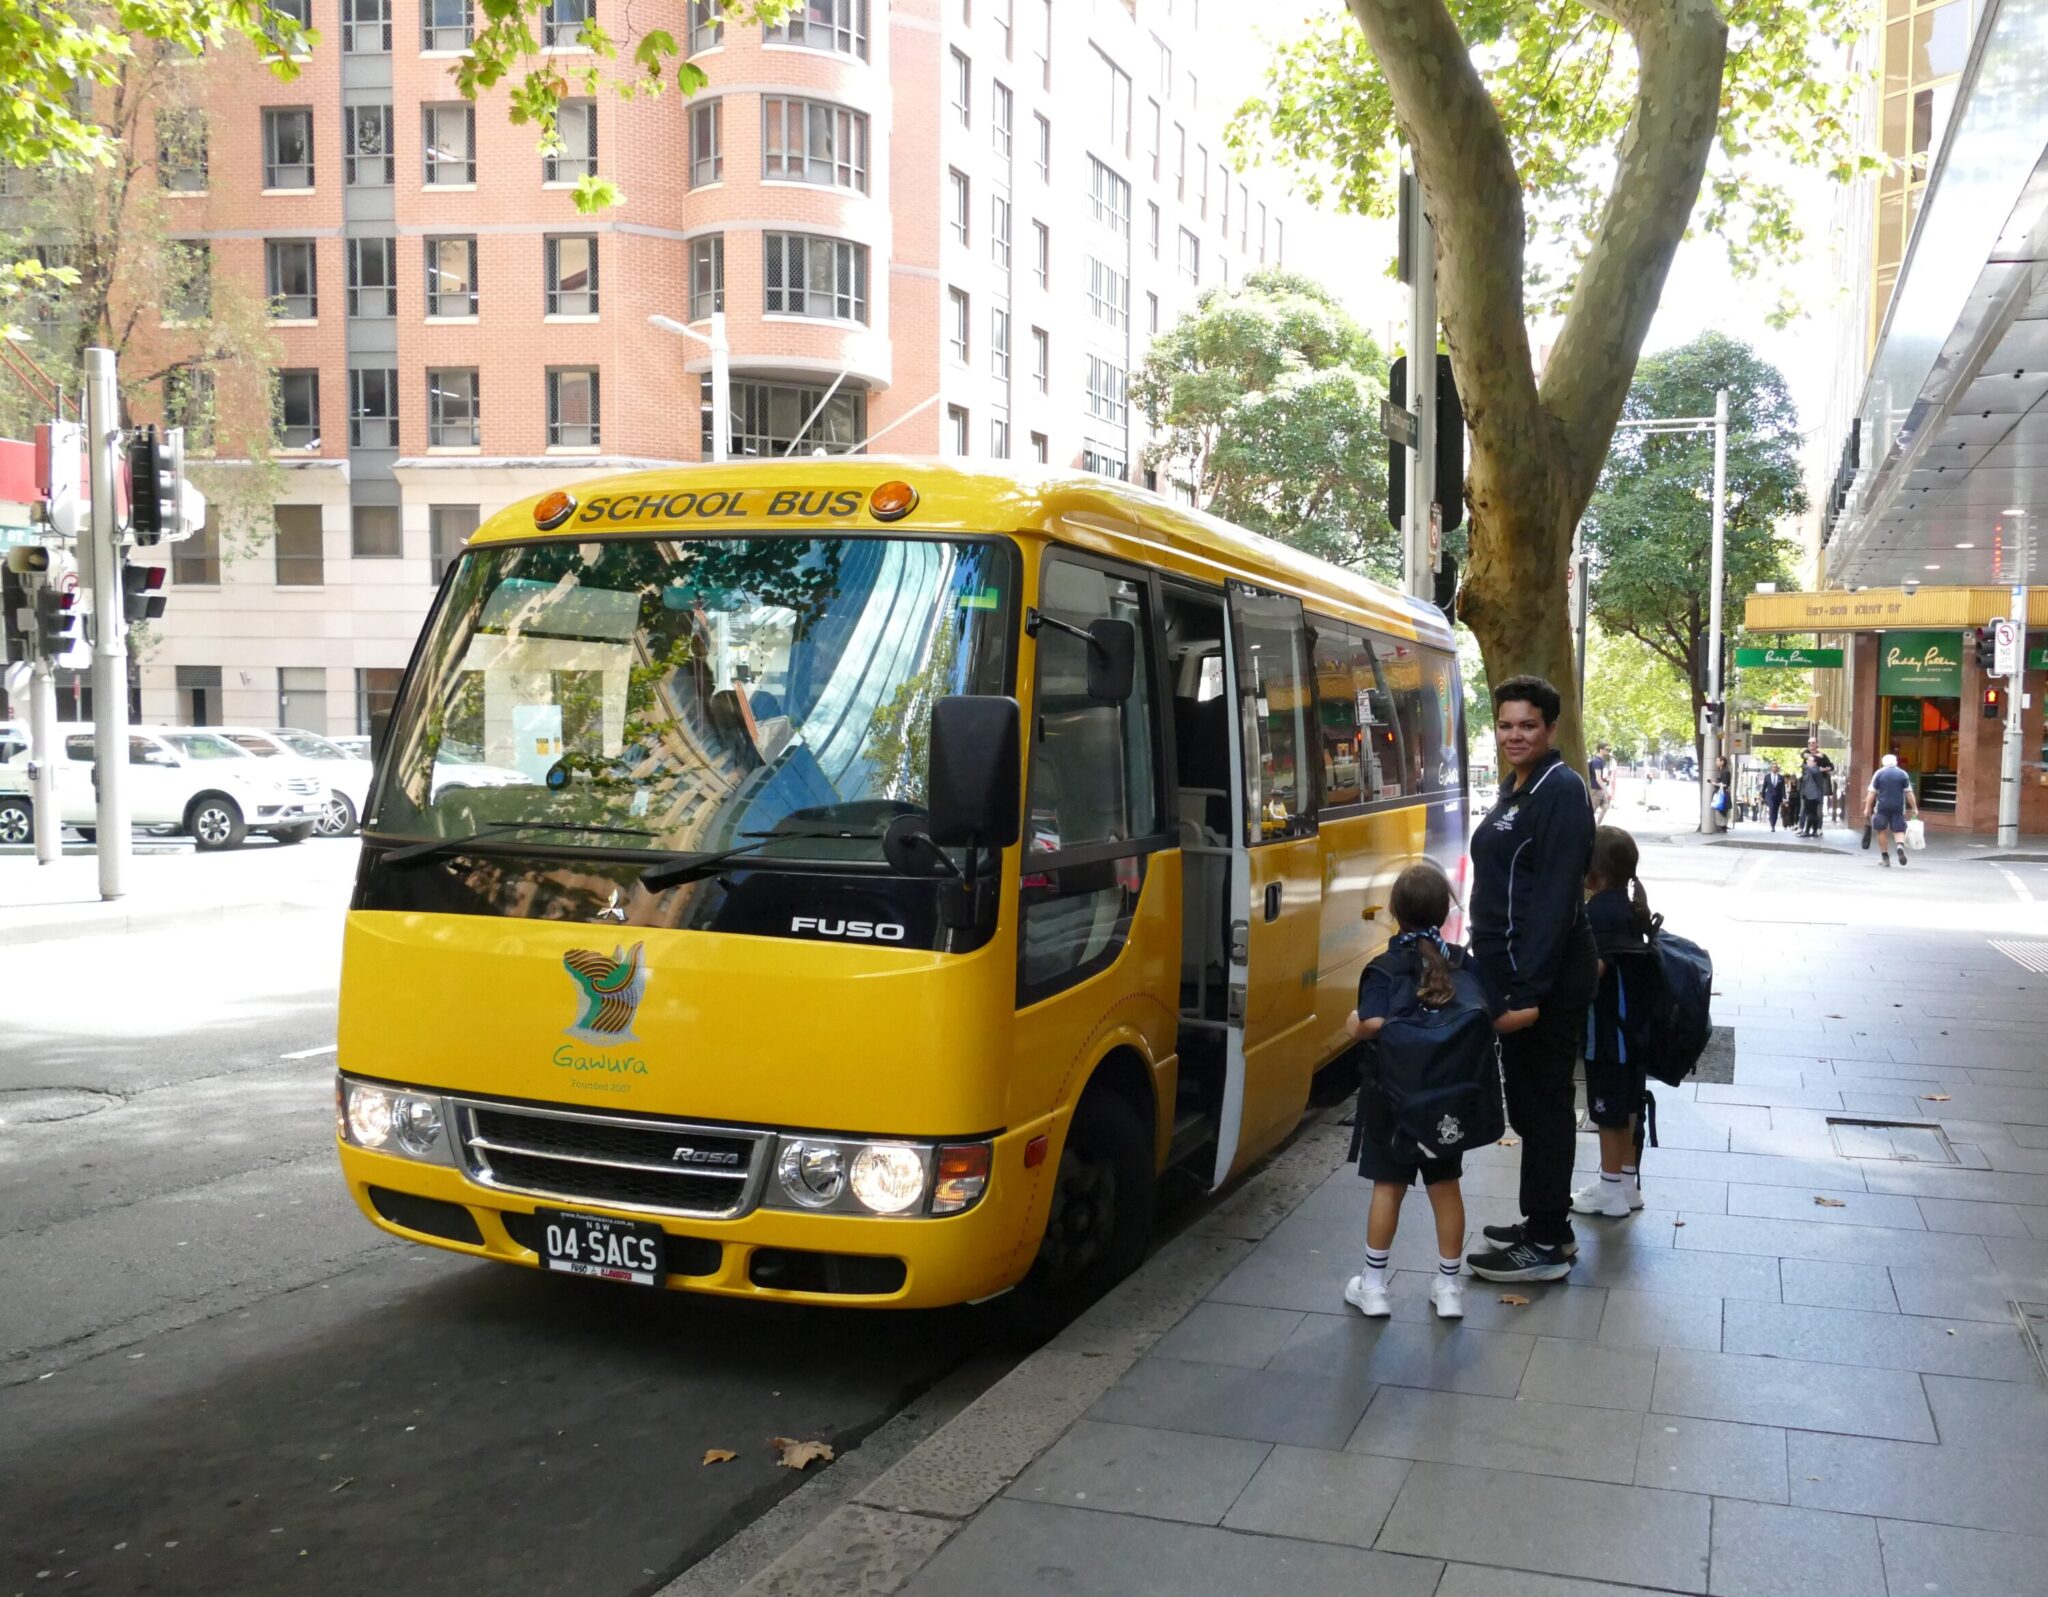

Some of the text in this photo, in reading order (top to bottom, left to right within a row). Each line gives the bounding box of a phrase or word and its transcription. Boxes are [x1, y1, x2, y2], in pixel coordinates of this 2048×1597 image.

[579, 490, 864, 522] SCHOOL BUS
[1765, 650, 1788, 666] Paddy
[1887, 645, 1957, 673] Paddy Pallin
[2000, 647, 2011, 656] NO
[791, 916, 905, 941] FUSO
[552, 1044, 648, 1074] Gawura
[571, 1079, 632, 1093] Founded 2007
[586, 1221, 610, 1232] NSW
[571, 1263, 588, 1273] FUSO
